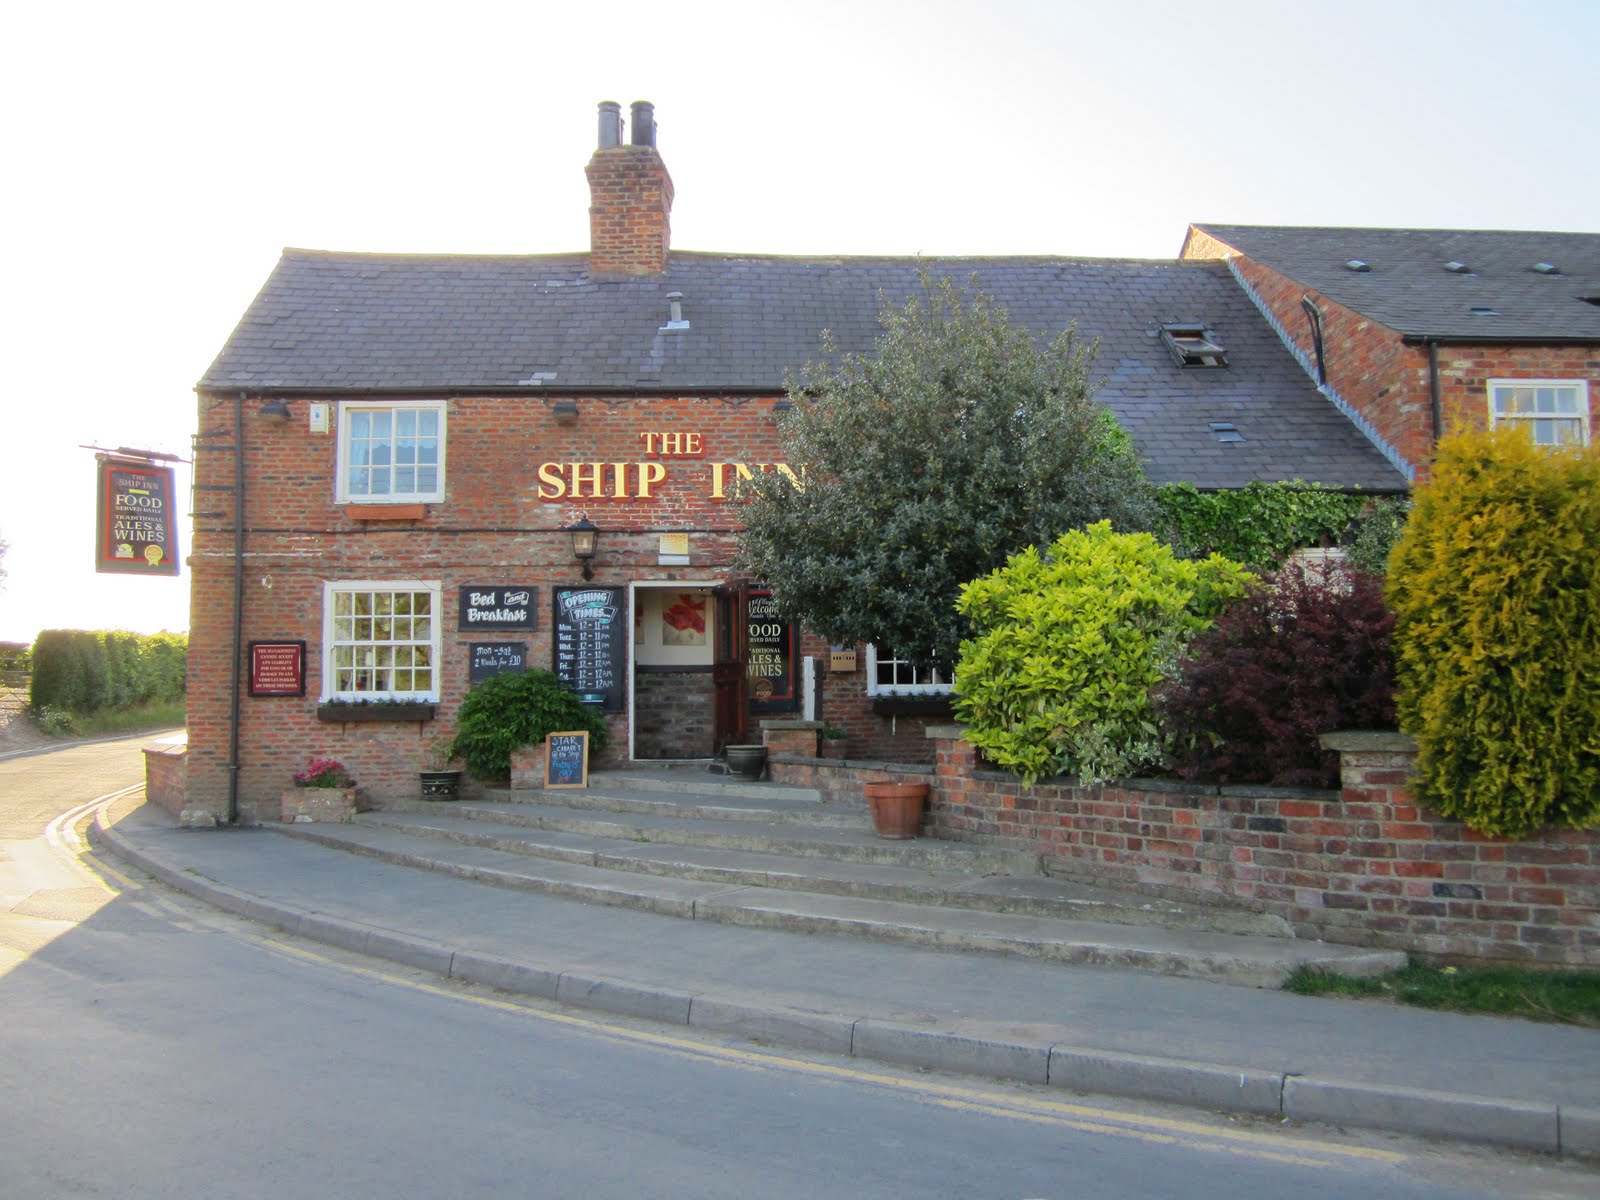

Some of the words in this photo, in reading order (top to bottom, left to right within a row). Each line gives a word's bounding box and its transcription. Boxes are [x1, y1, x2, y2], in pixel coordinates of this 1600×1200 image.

[640, 432, 702, 454] THE
[119, 479, 140, 487] SHIP
[537, 462, 666, 499] SHIP
[115, 494, 162, 508] FOOD
[114, 521, 152, 530] ALES
[155, 523, 163, 531] &
[115, 530, 164, 542] WINES
[470, 592, 495, 606] Bed
[507, 593, 525, 603] and
[564, 592, 607, 608] OPENING
[467, 608, 527, 622] Breakfast
[749, 624, 781, 637] OOD
[476, 647, 492, 655] Mon
[474, 659, 479, 667] 2
[509, 655, 520, 666] £10
[774, 654, 781, 664] &
[552, 736, 577, 746] STAR
[552, 751, 558, 759] @
